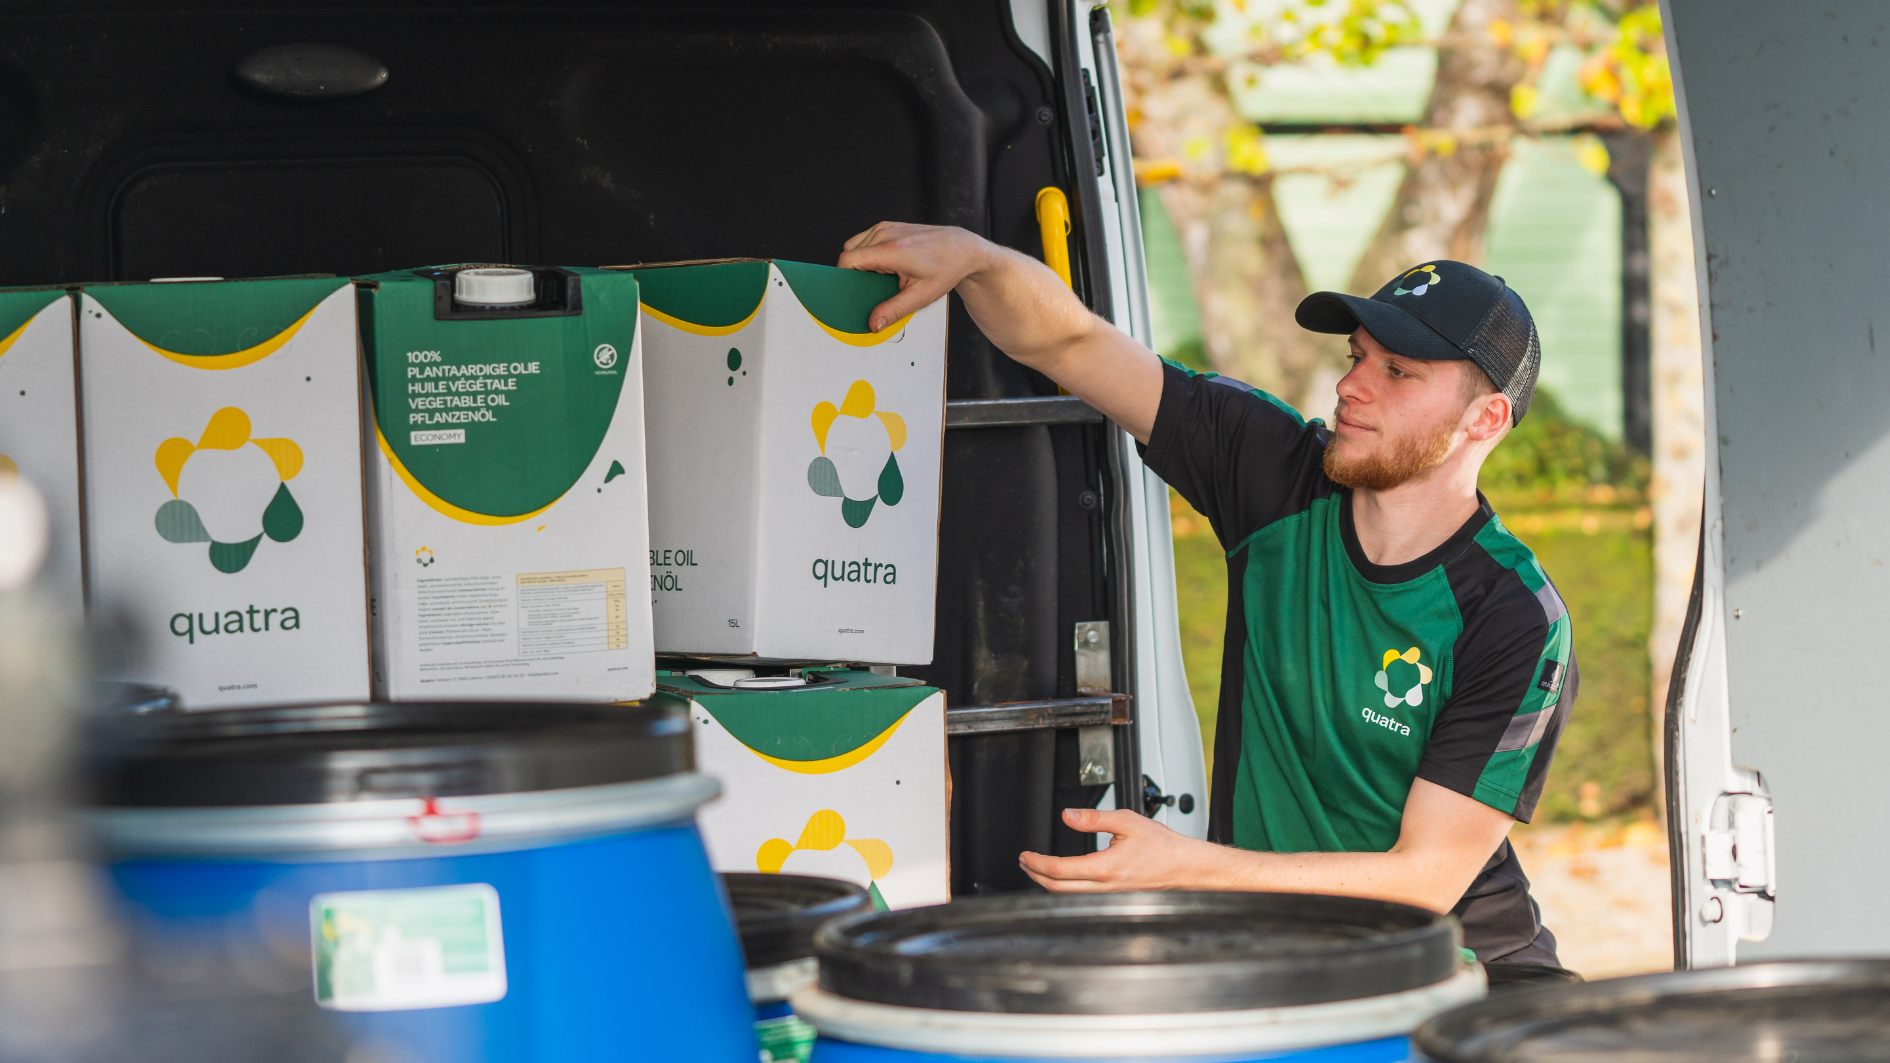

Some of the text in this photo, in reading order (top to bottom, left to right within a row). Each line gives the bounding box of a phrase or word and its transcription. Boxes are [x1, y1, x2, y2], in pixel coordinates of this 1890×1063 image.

[406, 350, 442, 363] 100%
[407, 362, 540, 379] PLANTAARDIGE OLIE
[408, 377, 517, 394] HUILE VÉGÉTALE
[408, 394, 510, 410] VEGETABLE OIL
[409, 410, 497, 425] PFLANZENÖL
[413, 432, 463, 443] ECONOMY
[674, 549, 698, 566] OIL
[811, 557, 897, 588] quatra
[169, 604, 301, 645] quatra
[218, 682, 258, 692] quatra.com
[1361, 706, 1411, 737] quatra
